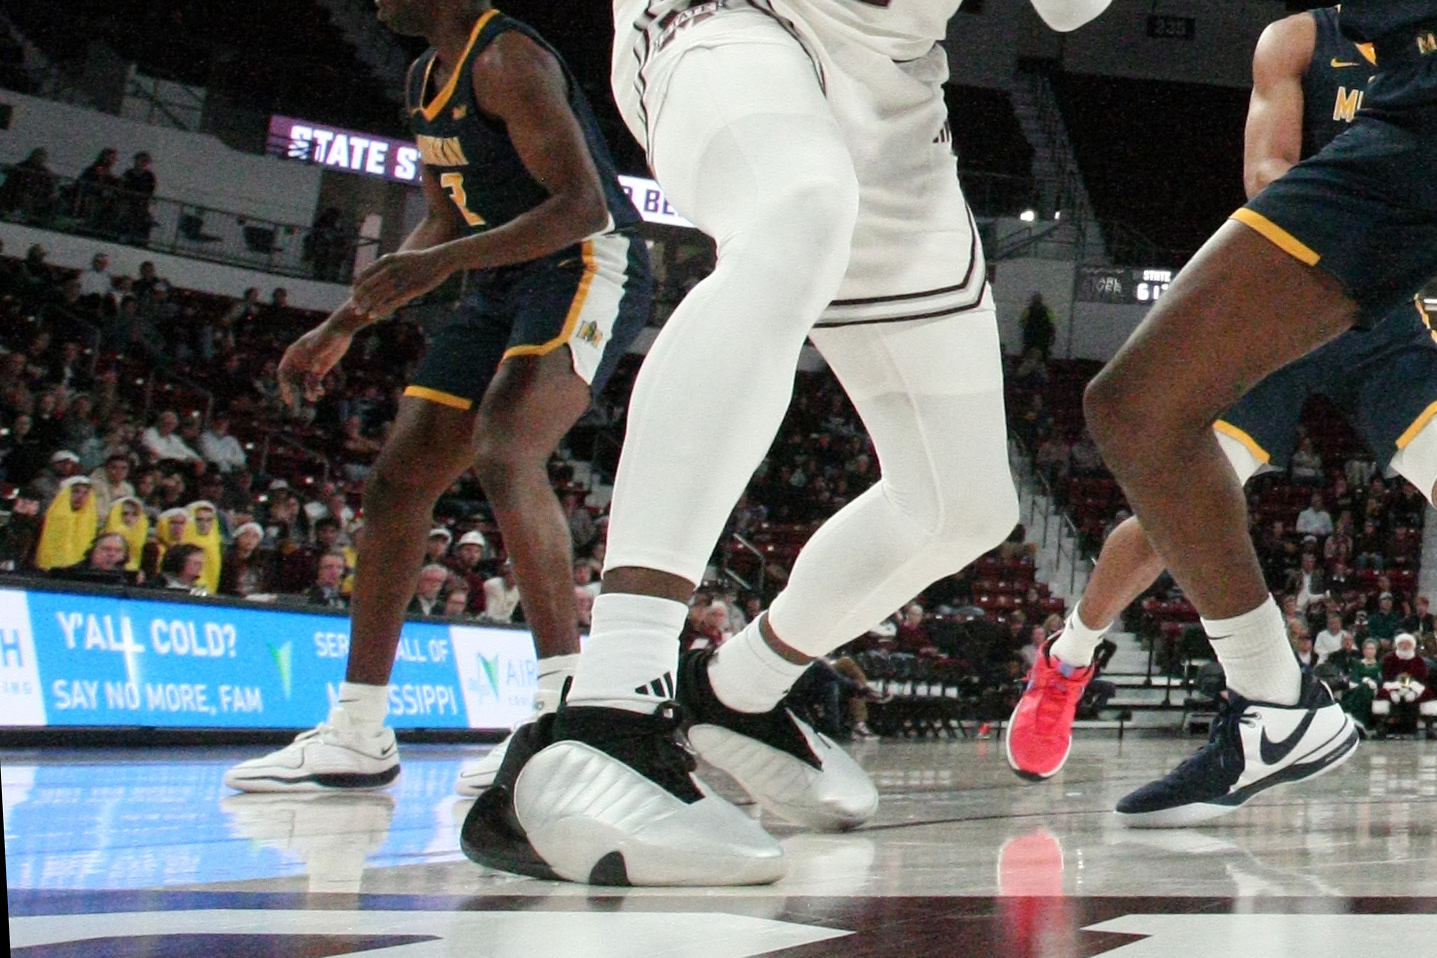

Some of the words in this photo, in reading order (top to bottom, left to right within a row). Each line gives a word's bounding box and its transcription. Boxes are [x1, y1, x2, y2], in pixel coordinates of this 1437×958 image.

[287, 125, 389, 174] STATE
[56, 611, 146, 653] Y'ALL
[151, 619, 237, 658] COLD?
[428, 638, 448, 662] OF
[53, 679, 99, 710] SAY
[104, 679, 142, 710] NO
[145, 683, 217, 716] MORE,
[218, 685, 264, 713] FAM
